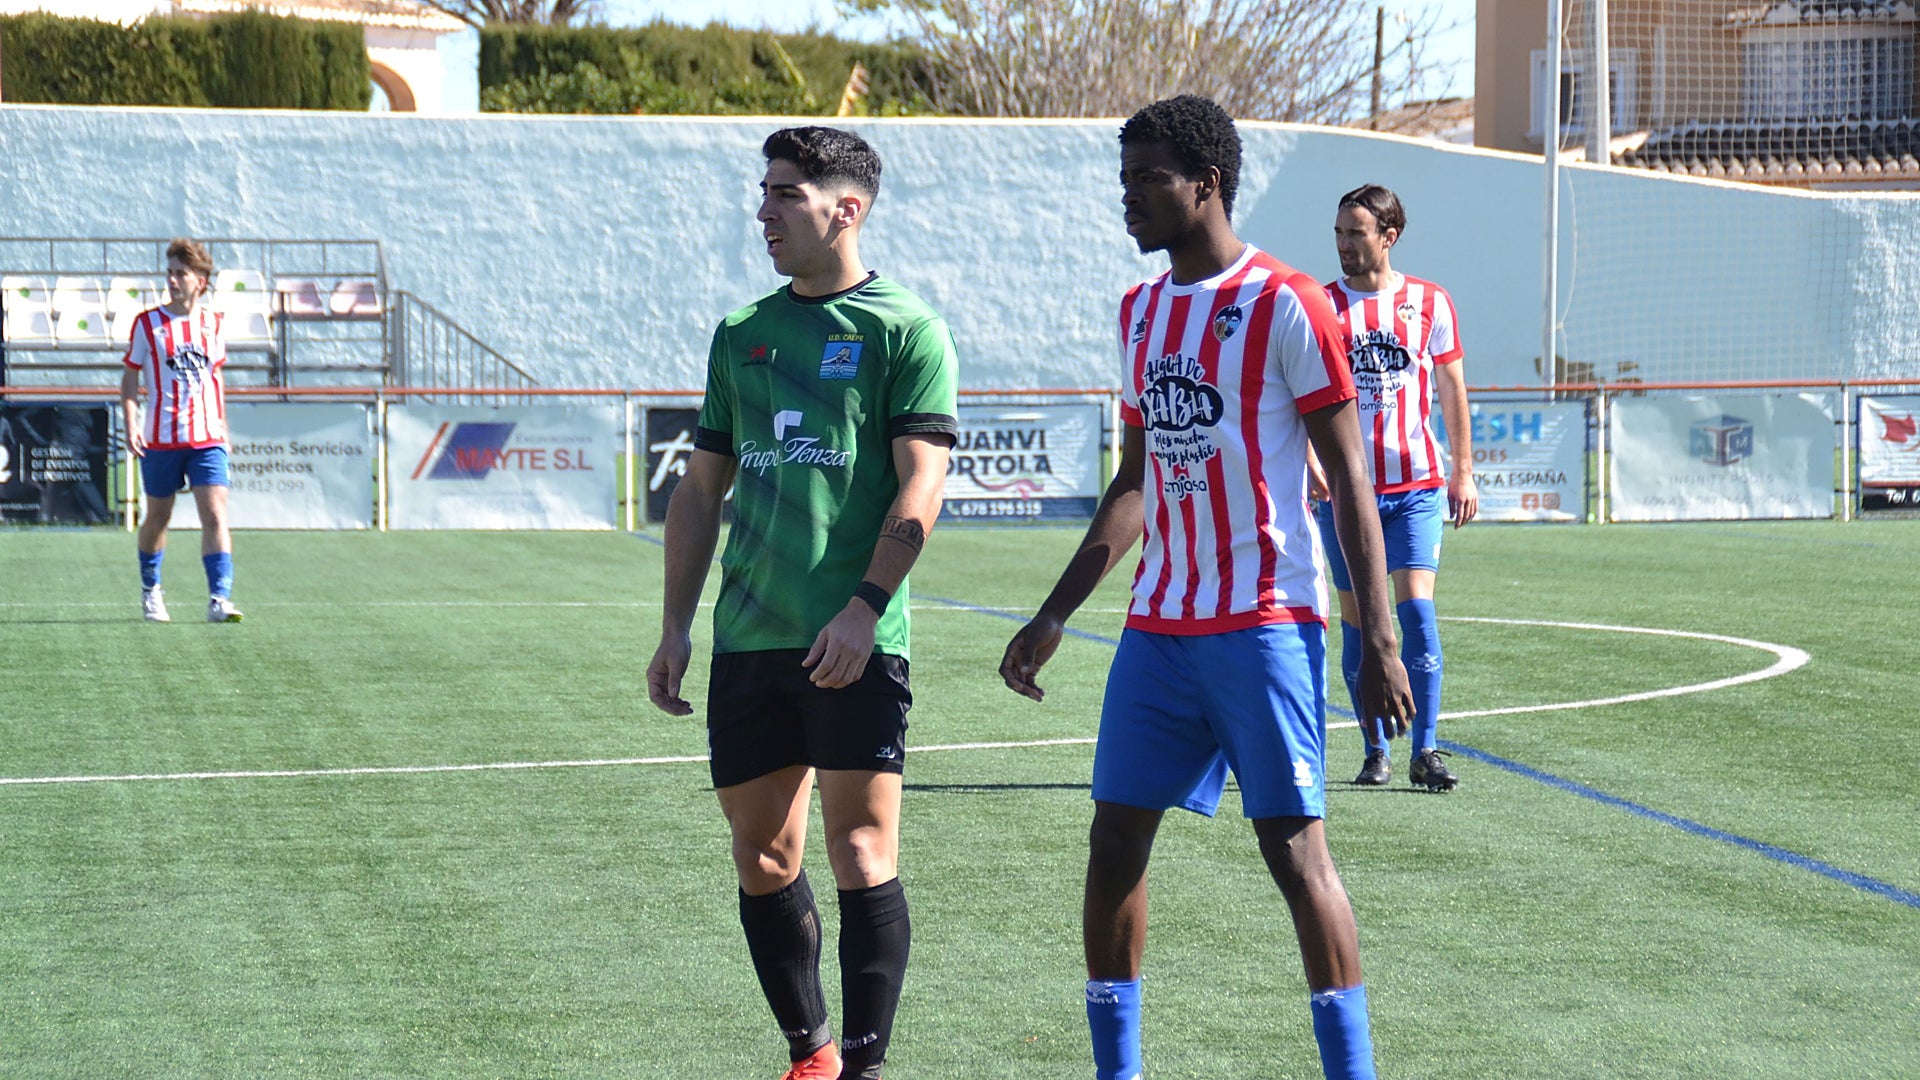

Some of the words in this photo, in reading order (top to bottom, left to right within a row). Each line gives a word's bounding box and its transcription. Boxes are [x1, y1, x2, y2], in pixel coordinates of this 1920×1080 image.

[1437, 413, 1542, 441] ESH
[289, 441, 363, 455] Servicios
[957, 429, 1046, 450] UANVI
[456, 449, 546, 471] MAYTE
[781, 437, 851, 467] Tenza
[229, 459, 313, 475] nergéticos
